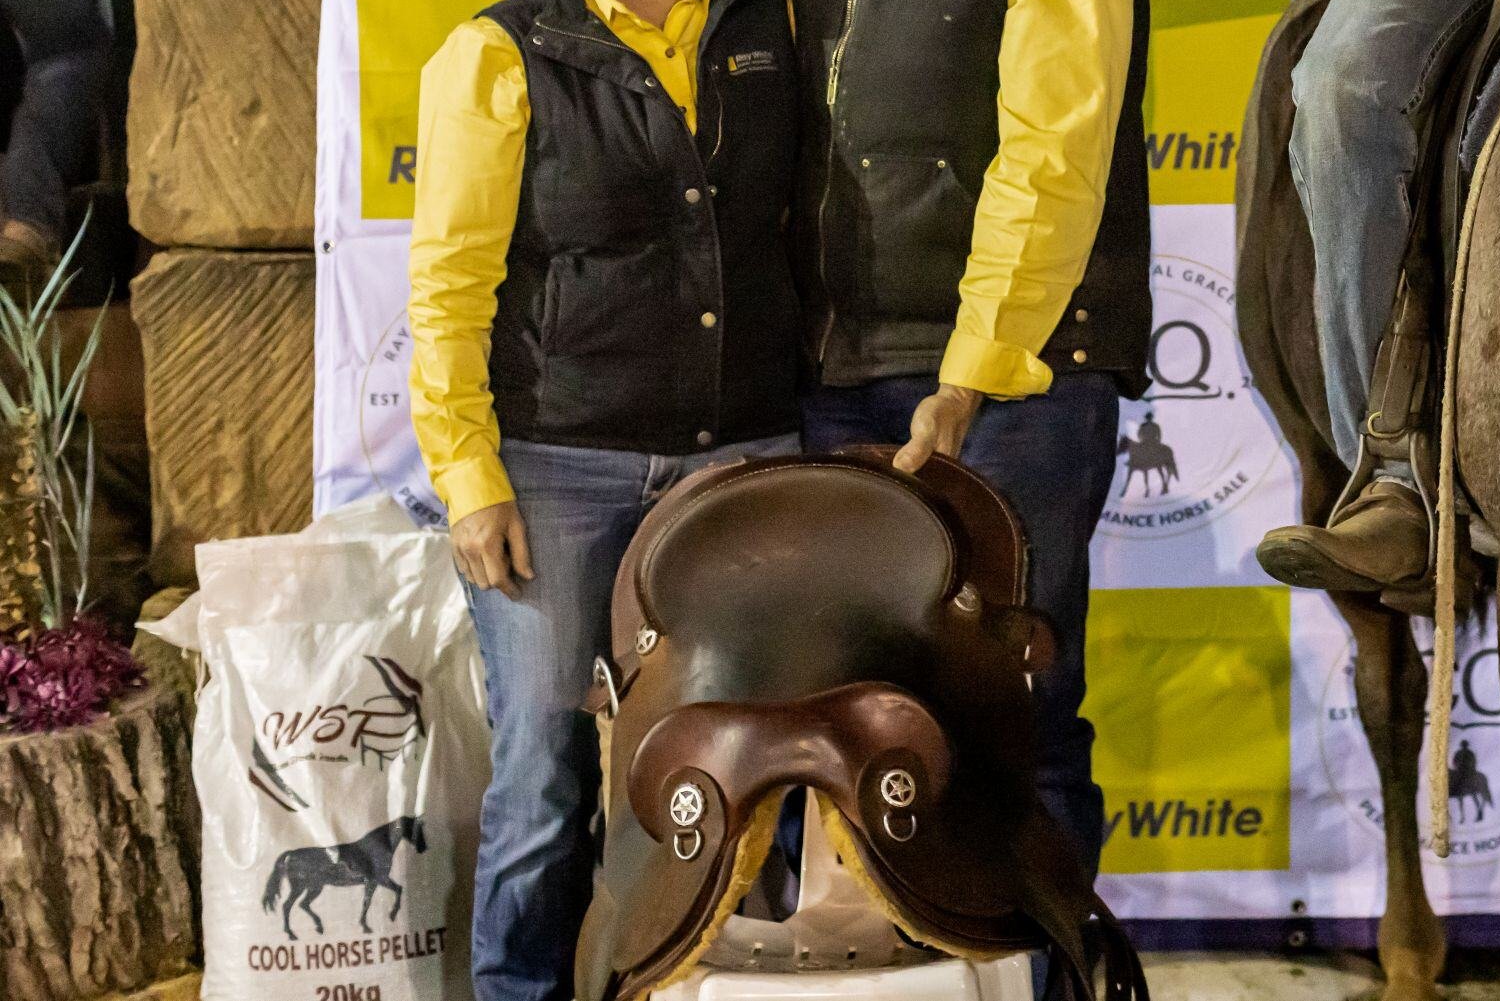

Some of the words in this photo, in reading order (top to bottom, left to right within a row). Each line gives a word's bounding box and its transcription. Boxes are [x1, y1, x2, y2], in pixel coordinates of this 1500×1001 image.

[384, 326, 410, 362] RAY
[369, 392, 400, 406] EST
[1159, 498, 1214, 528] HORSE
[1213, 469, 1249, 503] SALE
[249, 945, 301, 971] COOL
[306, 939, 375, 970] HORSE
[379, 926, 447, 964] PELLET
